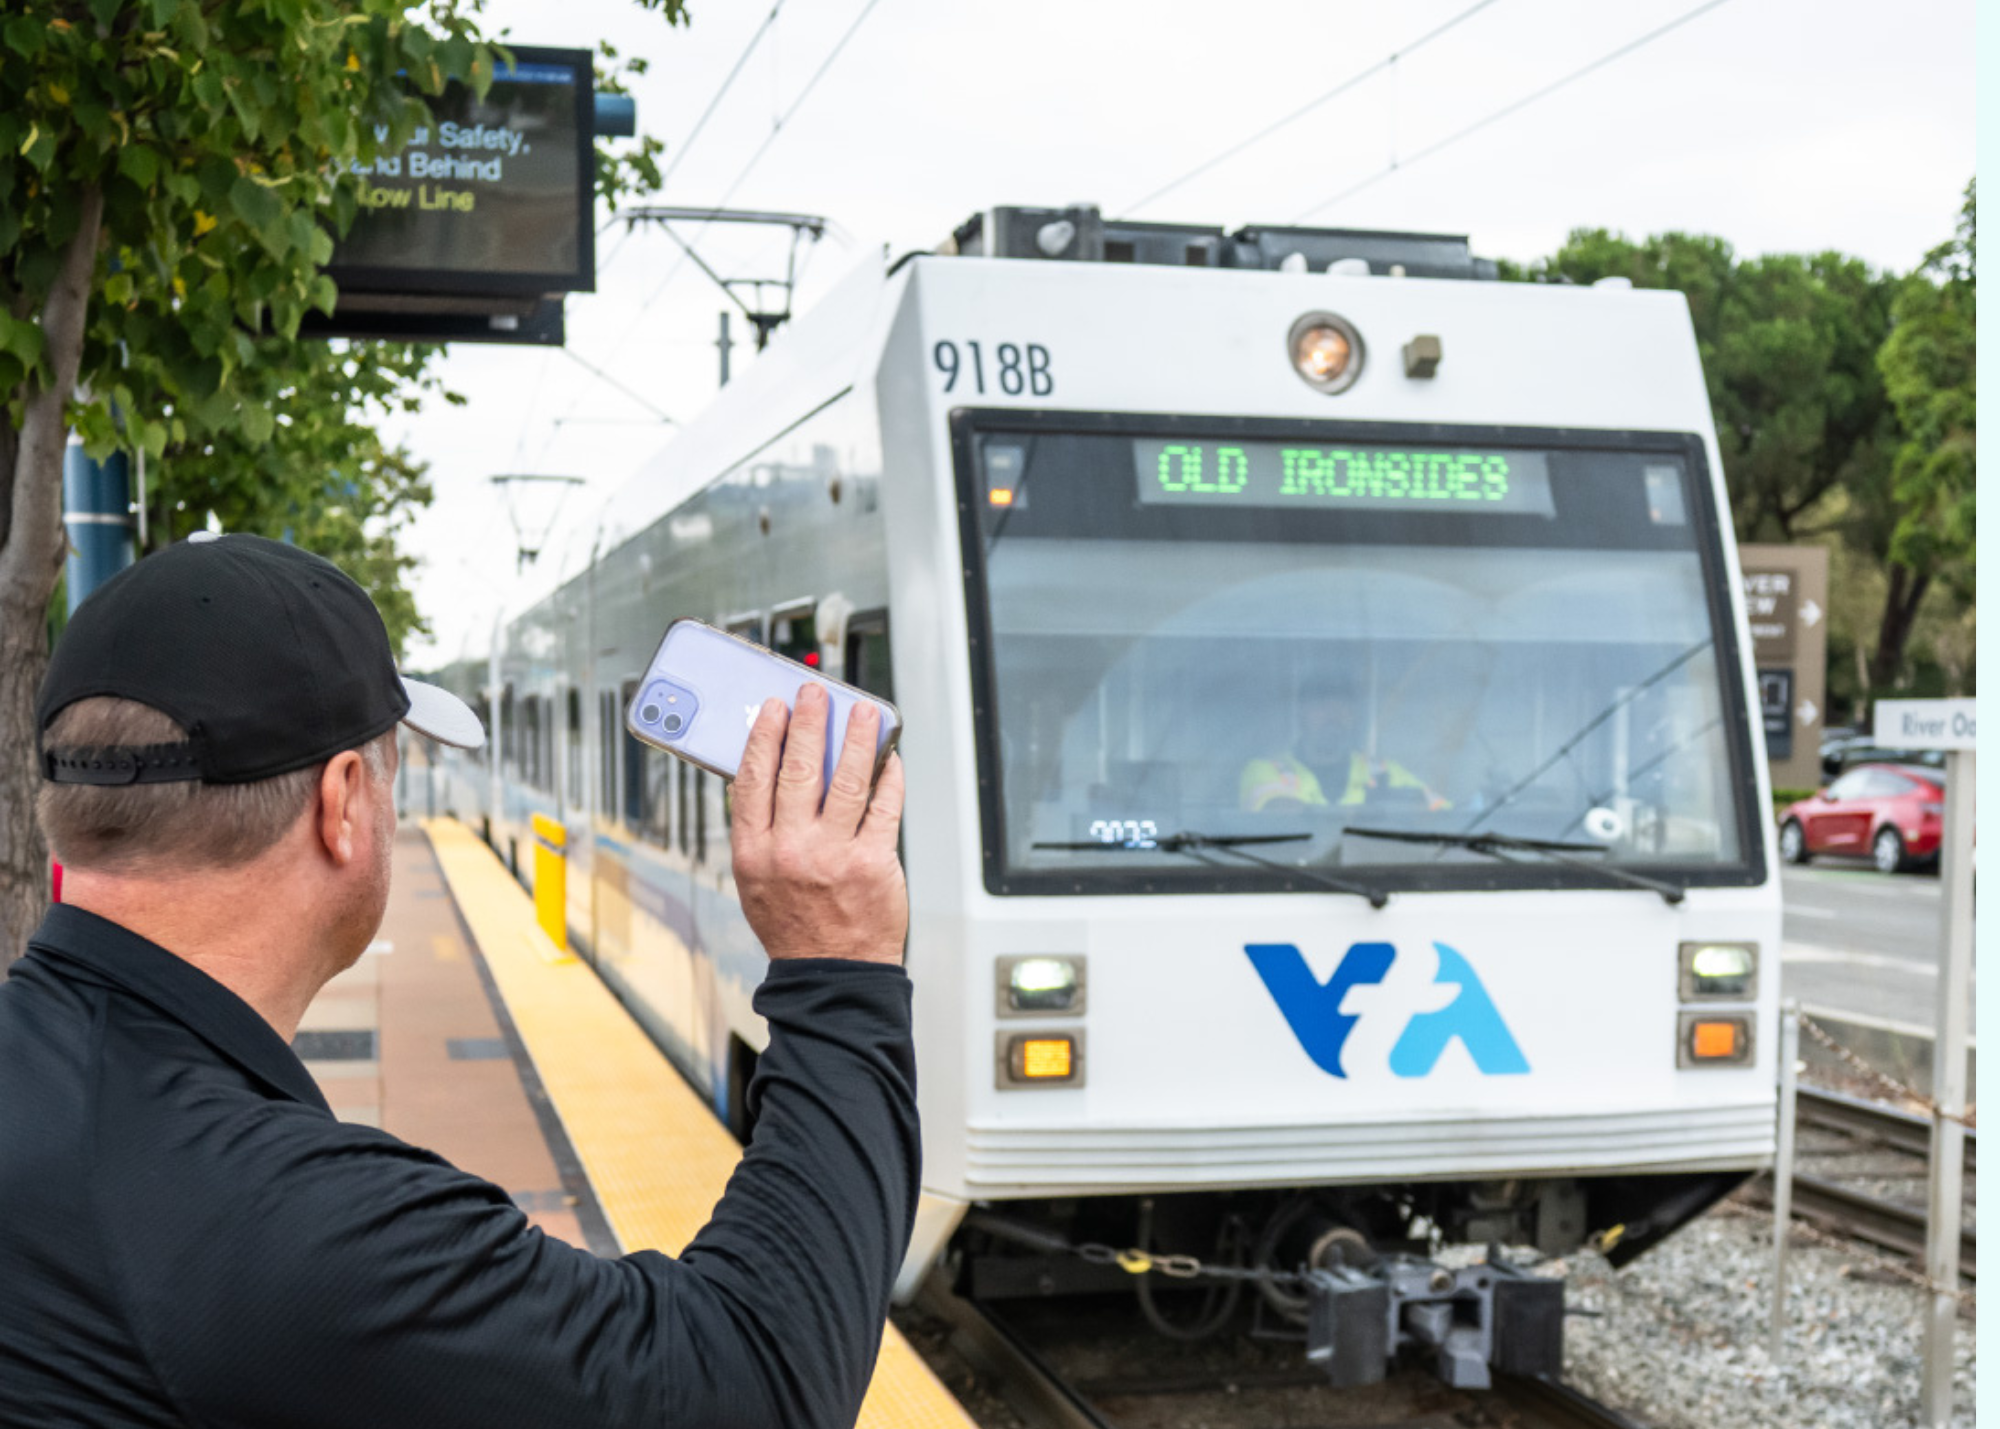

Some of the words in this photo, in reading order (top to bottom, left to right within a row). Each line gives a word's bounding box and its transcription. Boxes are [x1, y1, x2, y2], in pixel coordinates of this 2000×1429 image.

[439, 121, 532, 156] Safety,
[409, 151, 502, 181] Behind
[419, 183, 475, 212] Line
[934, 340, 1054, 396] 918B
[1158, 445, 1248, 493] OLD
[1279, 449, 1509, 501] IRONSIDES
[1902, 711, 1945, 737] River
